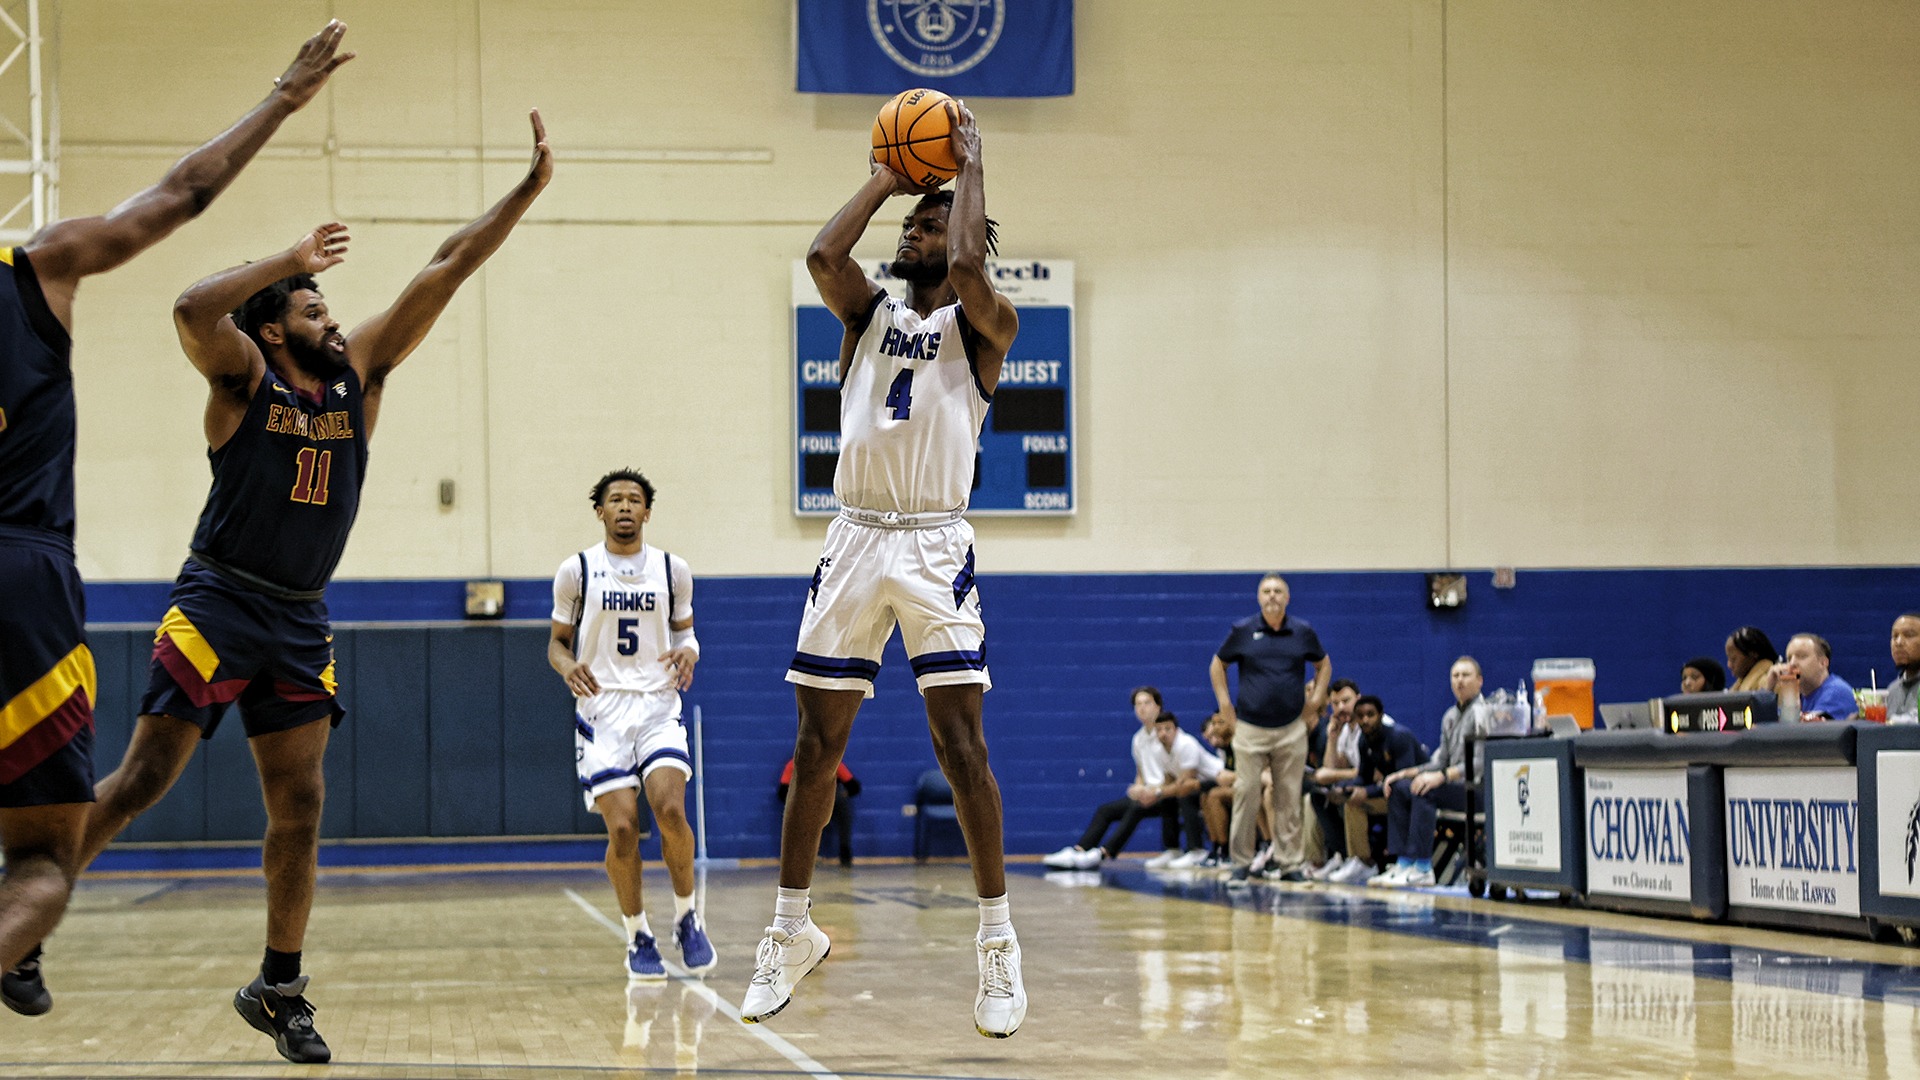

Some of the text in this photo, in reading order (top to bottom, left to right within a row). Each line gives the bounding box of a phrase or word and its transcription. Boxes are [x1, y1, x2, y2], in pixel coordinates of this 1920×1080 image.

[984, 262, 1050, 279] Tech
[879, 326, 941, 360] HAWKS
[999, 360, 1061, 383] GUEST
[885, 367, 914, 420] 4
[1022, 435, 1068, 451] FOULS
[290, 446, 331, 505] 11
[802, 493, 842, 509] SCOR
[1024, 493, 1068, 508] SCORE
[858, 513, 918, 526] UNER
[602, 591, 656, 611] HAWKS
[617, 618, 639, 655] 5
[1589, 796, 1690, 865] CHOWAN
[1729, 798, 1858, 873] UNIVERSITY
[1612, 871, 1673, 892] www.Chowan.edu
[1750, 877, 1837, 905] Home of the HAWKS
